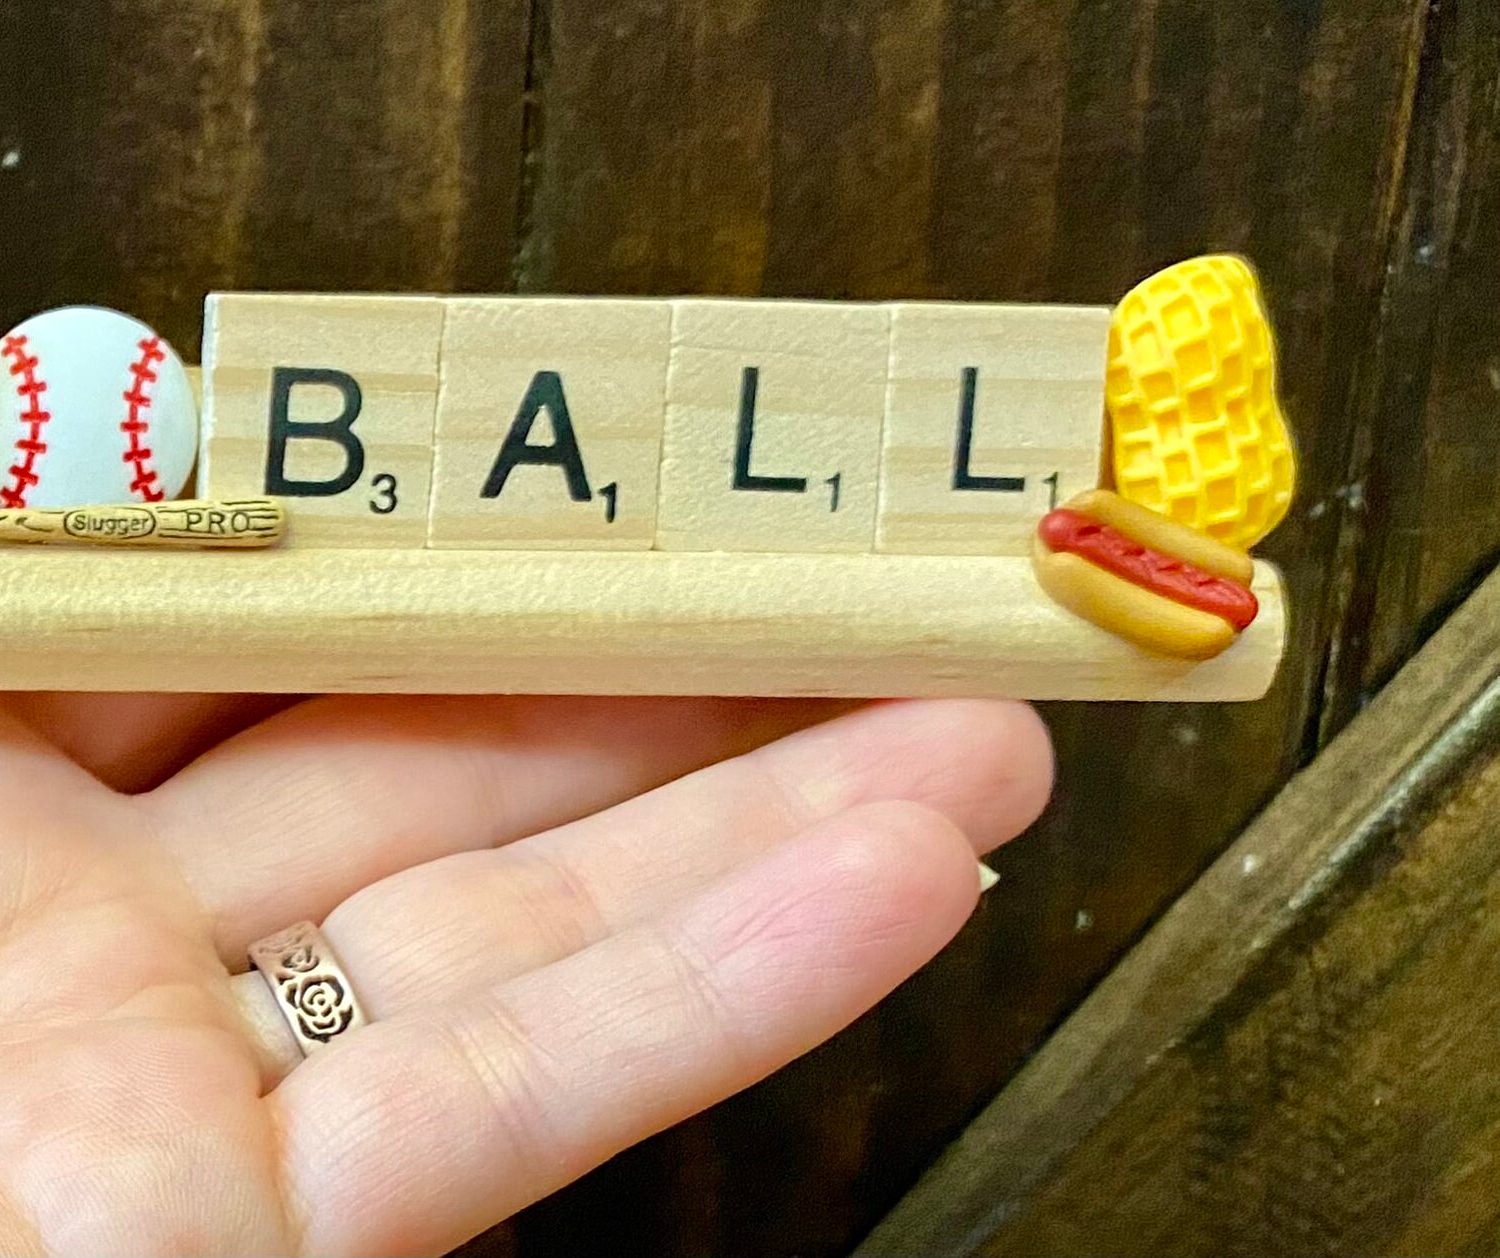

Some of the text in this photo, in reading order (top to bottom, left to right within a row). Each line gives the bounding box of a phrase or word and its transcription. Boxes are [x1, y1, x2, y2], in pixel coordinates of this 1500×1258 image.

[369, 473, 398, 515] 3
[598, 481, 618, 524] 1
[825, 472, 841, 512] 1
[71, 509, 250, 536] Slugger PRO
